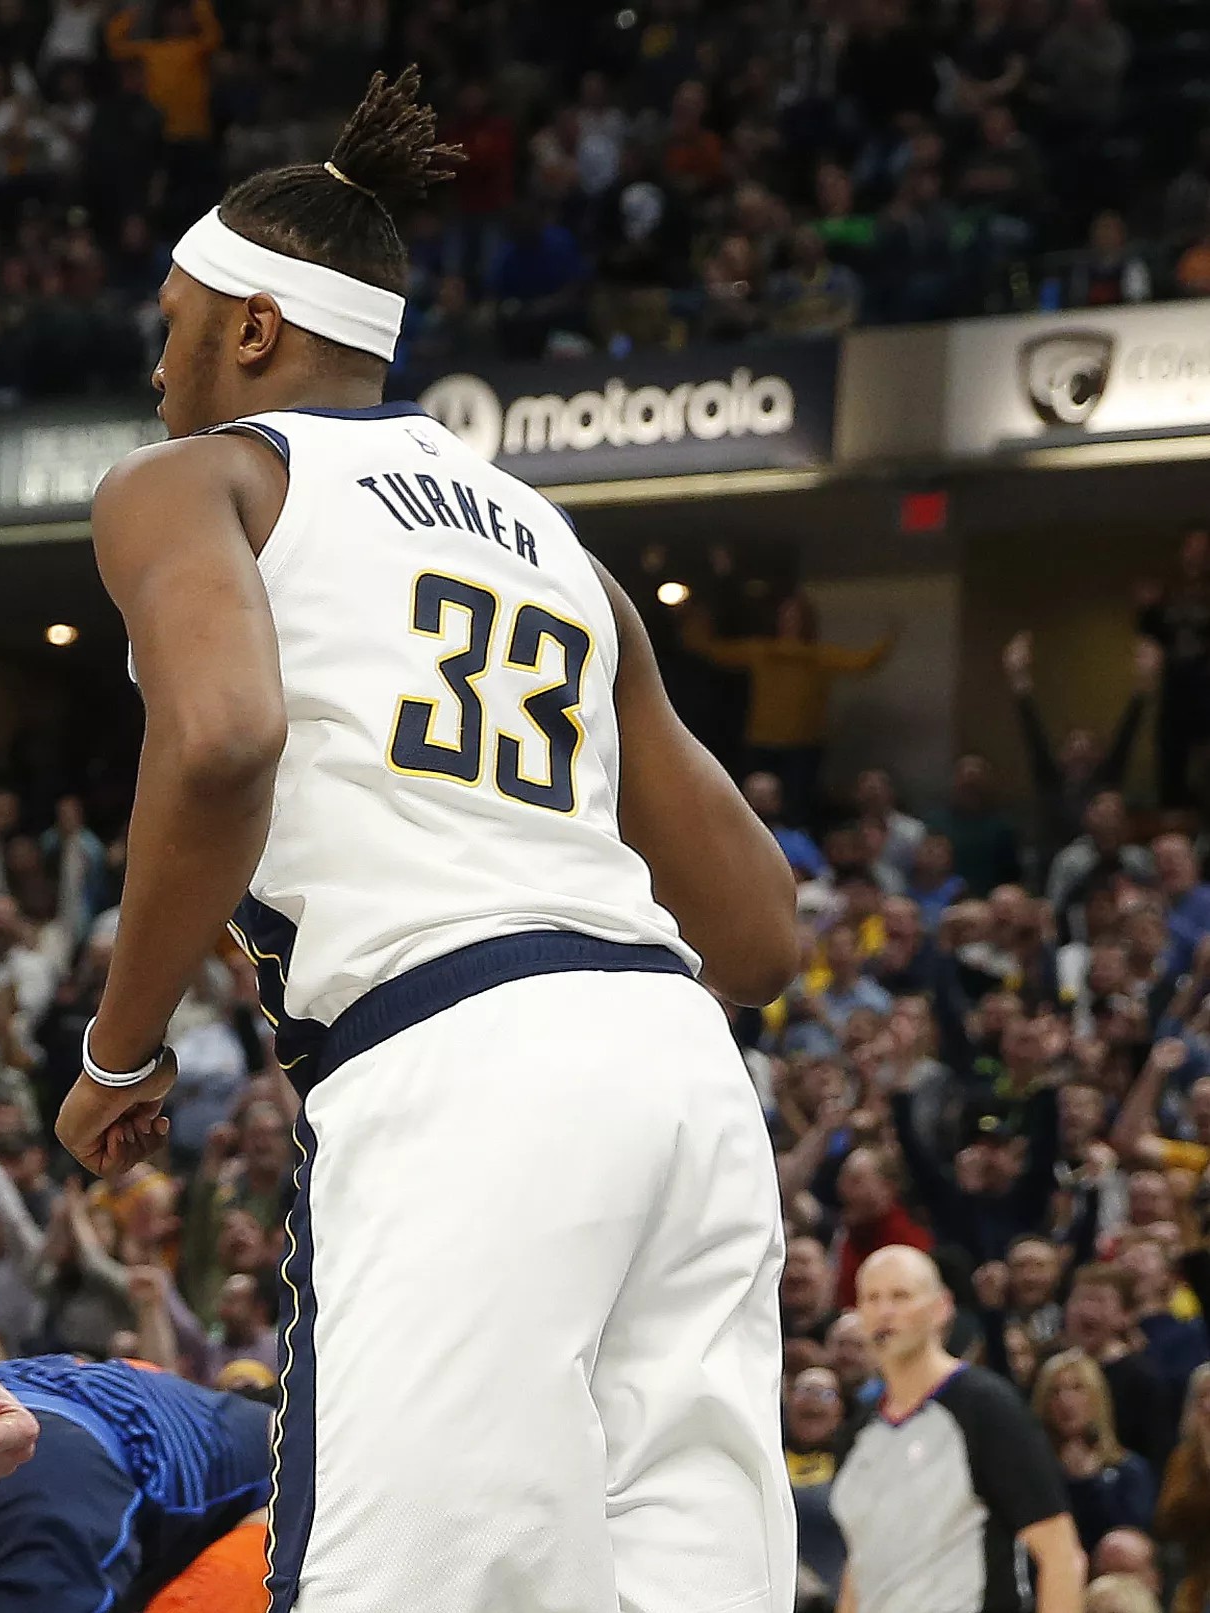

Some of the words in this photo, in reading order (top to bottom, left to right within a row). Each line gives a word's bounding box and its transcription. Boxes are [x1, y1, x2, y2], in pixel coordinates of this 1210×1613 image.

[502, 366, 794, 455] motorola
[356, 473, 539, 568] TURNER
[385, 568, 595, 818] 33
